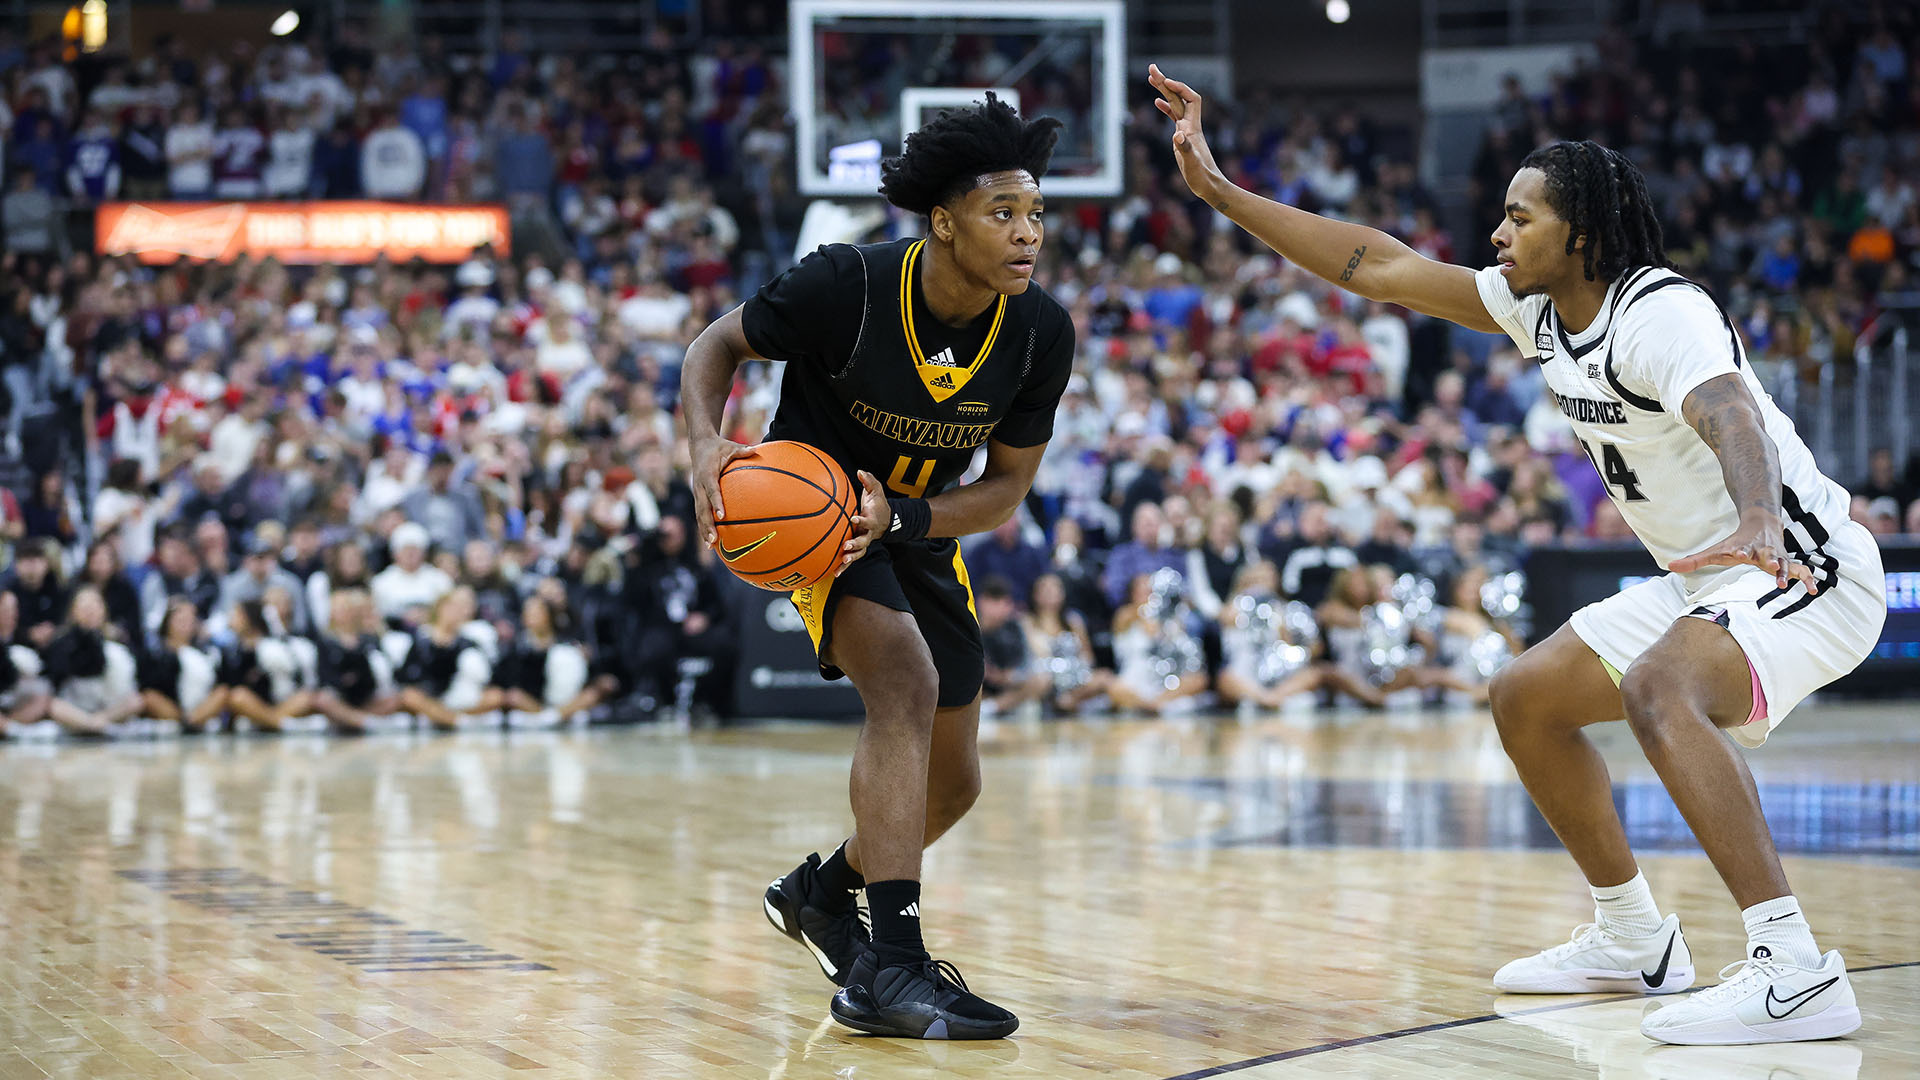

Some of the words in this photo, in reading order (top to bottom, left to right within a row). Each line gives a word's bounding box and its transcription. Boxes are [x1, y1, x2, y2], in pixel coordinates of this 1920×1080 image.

[930, 380, 956, 390] adidas
[957, 405, 989, 413] HORIZON
[886, 454, 937, 499] 4
